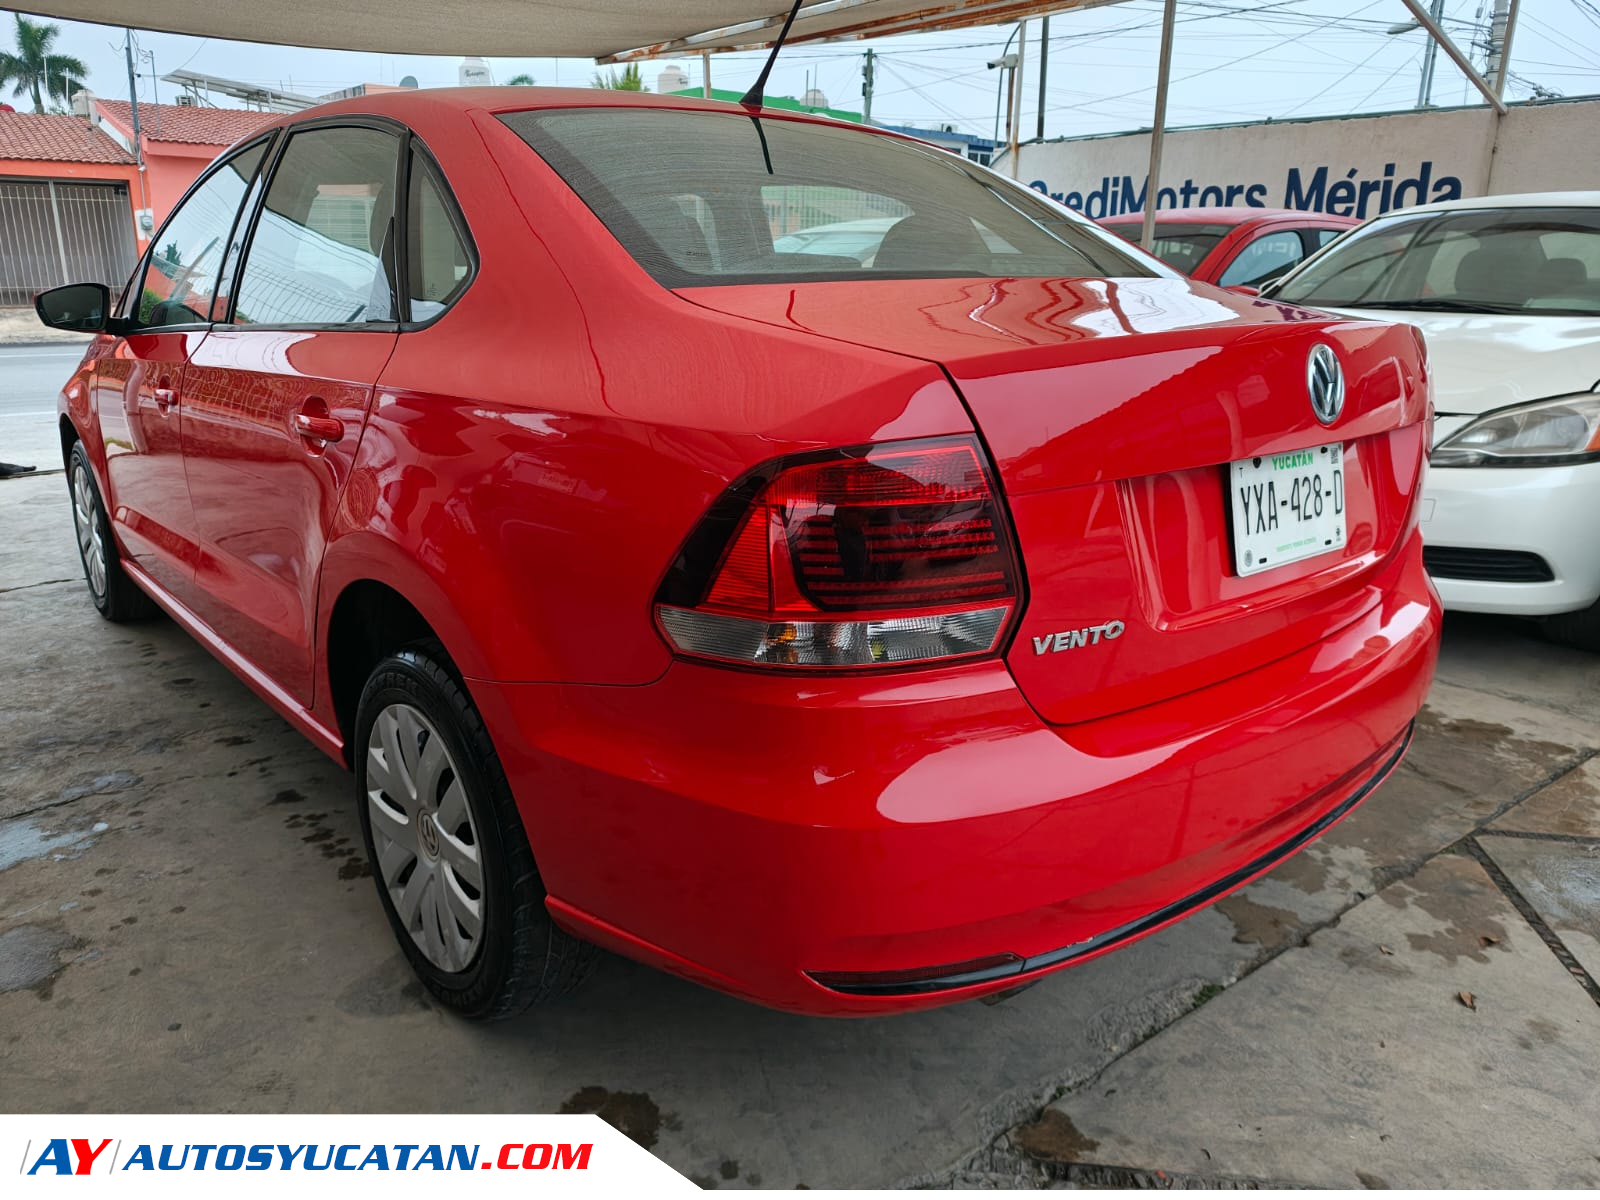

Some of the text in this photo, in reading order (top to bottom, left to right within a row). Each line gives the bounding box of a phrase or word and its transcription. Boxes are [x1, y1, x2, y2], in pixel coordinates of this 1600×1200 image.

[1284, 161, 1463, 220] Mérida
[1272, 451, 1314, 471] YUCATÁN
[1240, 470, 1343, 536] YXA-428-D
[1032, 620, 1126, 656] VENTO
